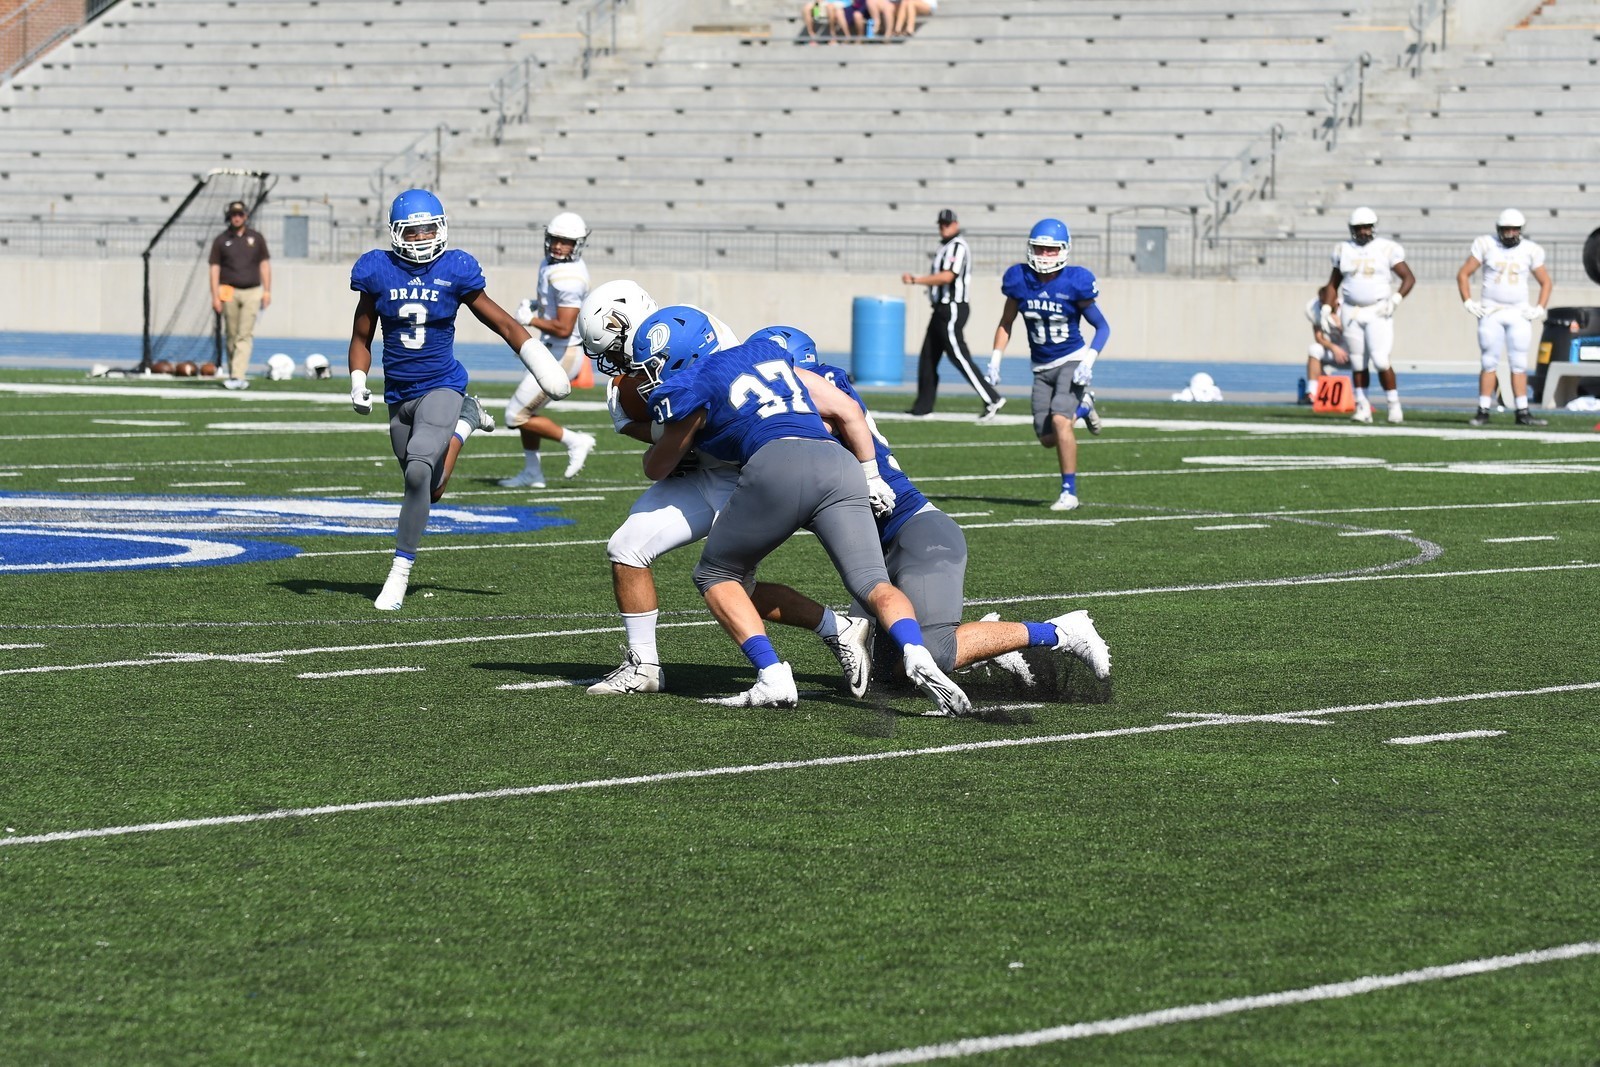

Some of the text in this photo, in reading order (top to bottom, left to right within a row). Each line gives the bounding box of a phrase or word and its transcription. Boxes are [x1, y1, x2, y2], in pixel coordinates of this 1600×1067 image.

[390, 288, 439, 302] DRAKE
[1027, 299, 1063, 313] DRAKE
[399, 303, 428, 349] 3
[729, 359, 814, 419] 37
[1318, 381, 1343, 406] 40
[653, 398, 673, 423] 37
